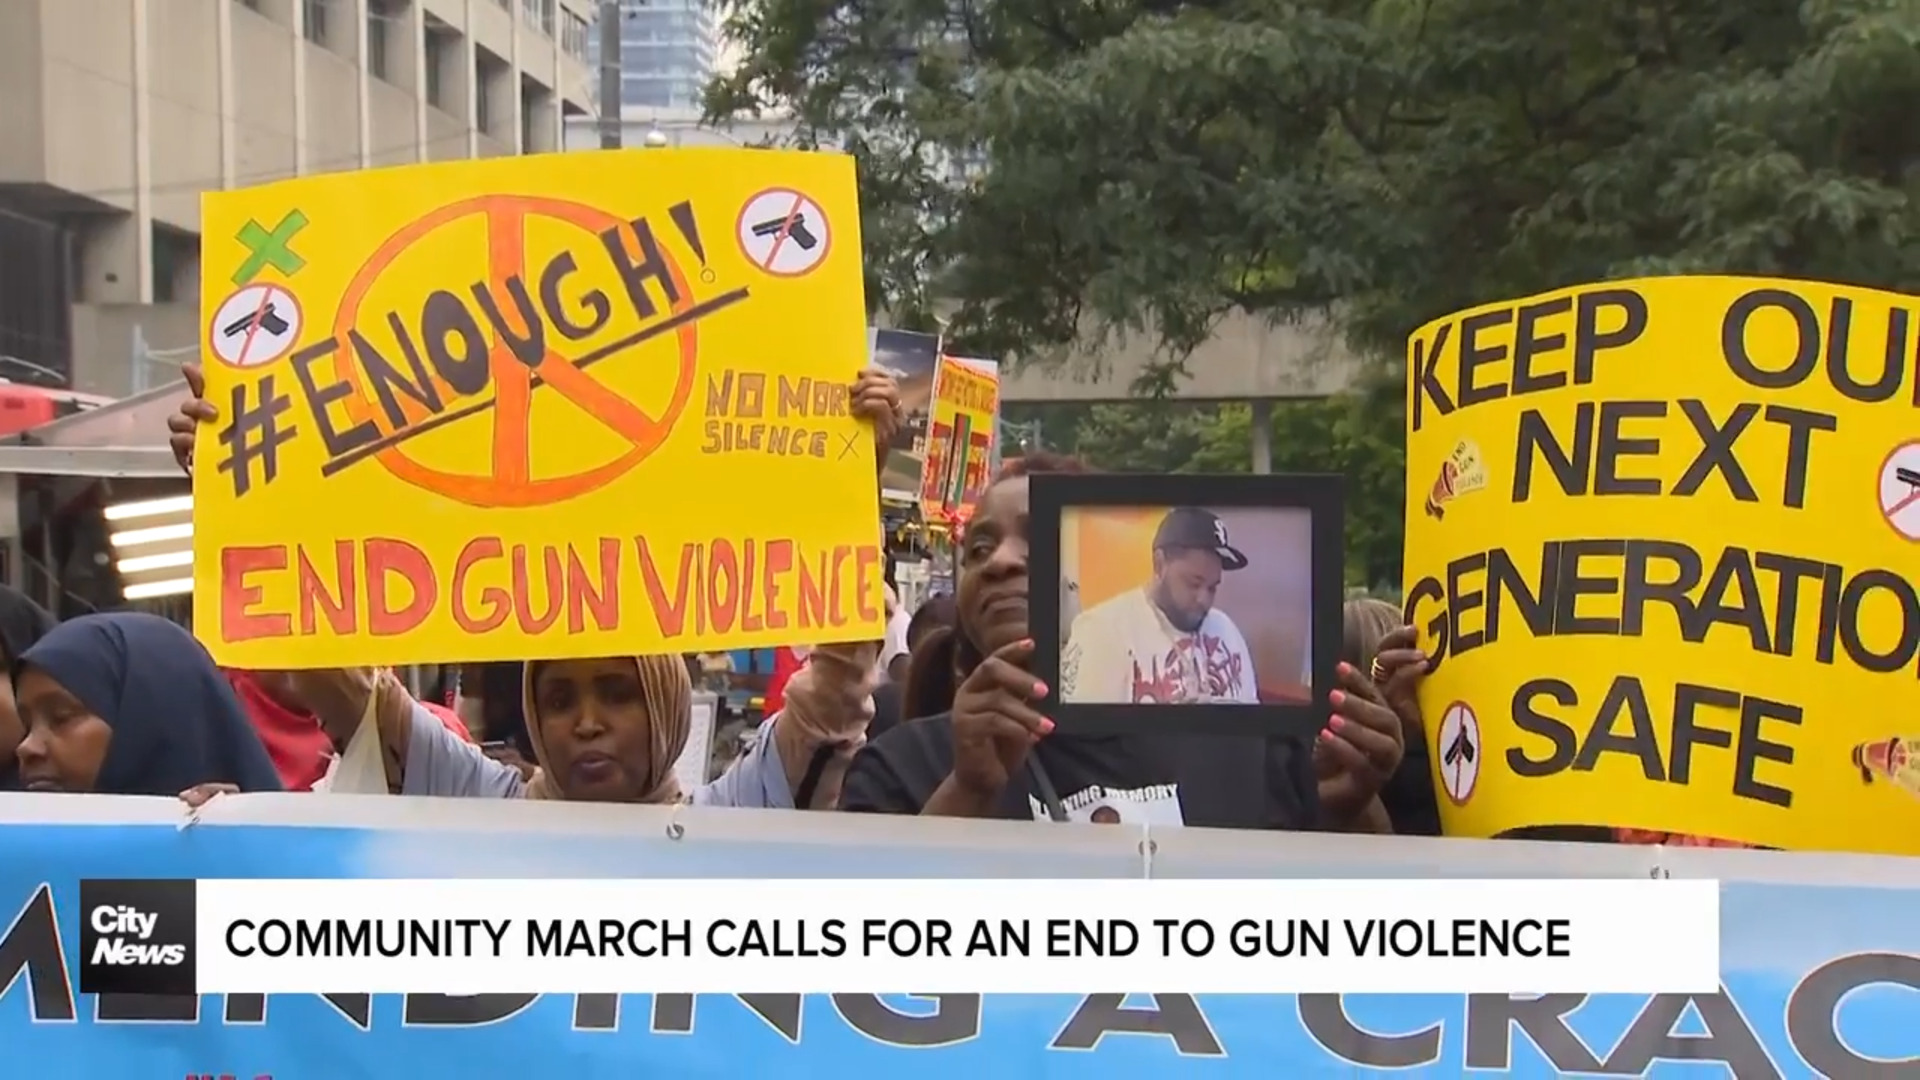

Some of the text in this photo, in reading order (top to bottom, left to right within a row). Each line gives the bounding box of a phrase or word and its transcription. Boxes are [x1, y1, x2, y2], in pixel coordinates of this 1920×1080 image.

[217, 199, 717, 498] #ENOUGH!
[704, 369, 858, 418] NO MOR
[1413, 288, 1920, 432] KEEP OU
[702, 420, 829, 458] SILENCE
[1511, 398, 1837, 509] NEXT
[220, 535, 879, 642] END GUN VIOLENCE
[1404, 539, 1920, 680] GENERATIO
[1506, 675, 1803, 808] SAFE
